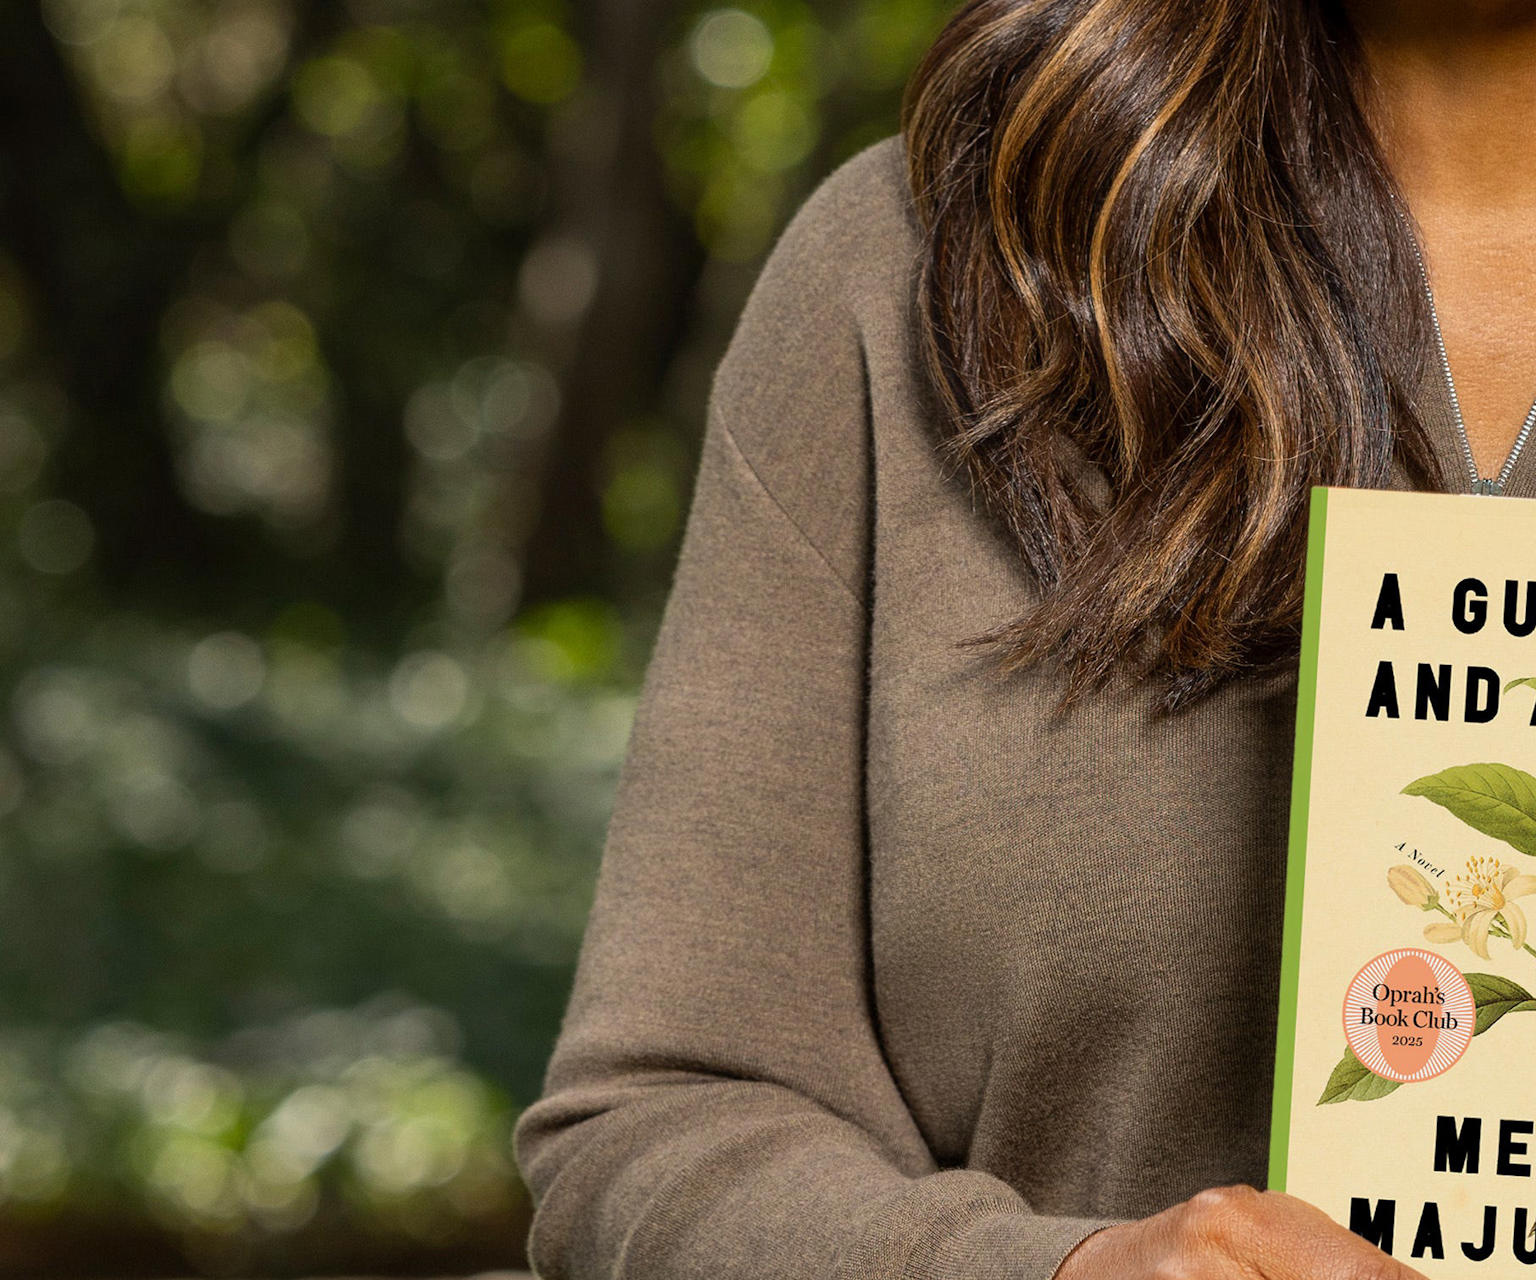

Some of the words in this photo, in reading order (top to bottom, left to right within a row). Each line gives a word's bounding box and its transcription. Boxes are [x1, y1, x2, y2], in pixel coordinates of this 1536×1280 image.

[1371, 573, 1405, 631] A
[1365, 661, 1500, 724] AND
[1394, 842, 1406, 851] A
[1407, 849, 1445, 878] Novel
[1360, 1007, 1409, 1027] Book
[1413, 1010, 1458, 1030] Club
[1391, 1035, 1423, 1047] 2025
